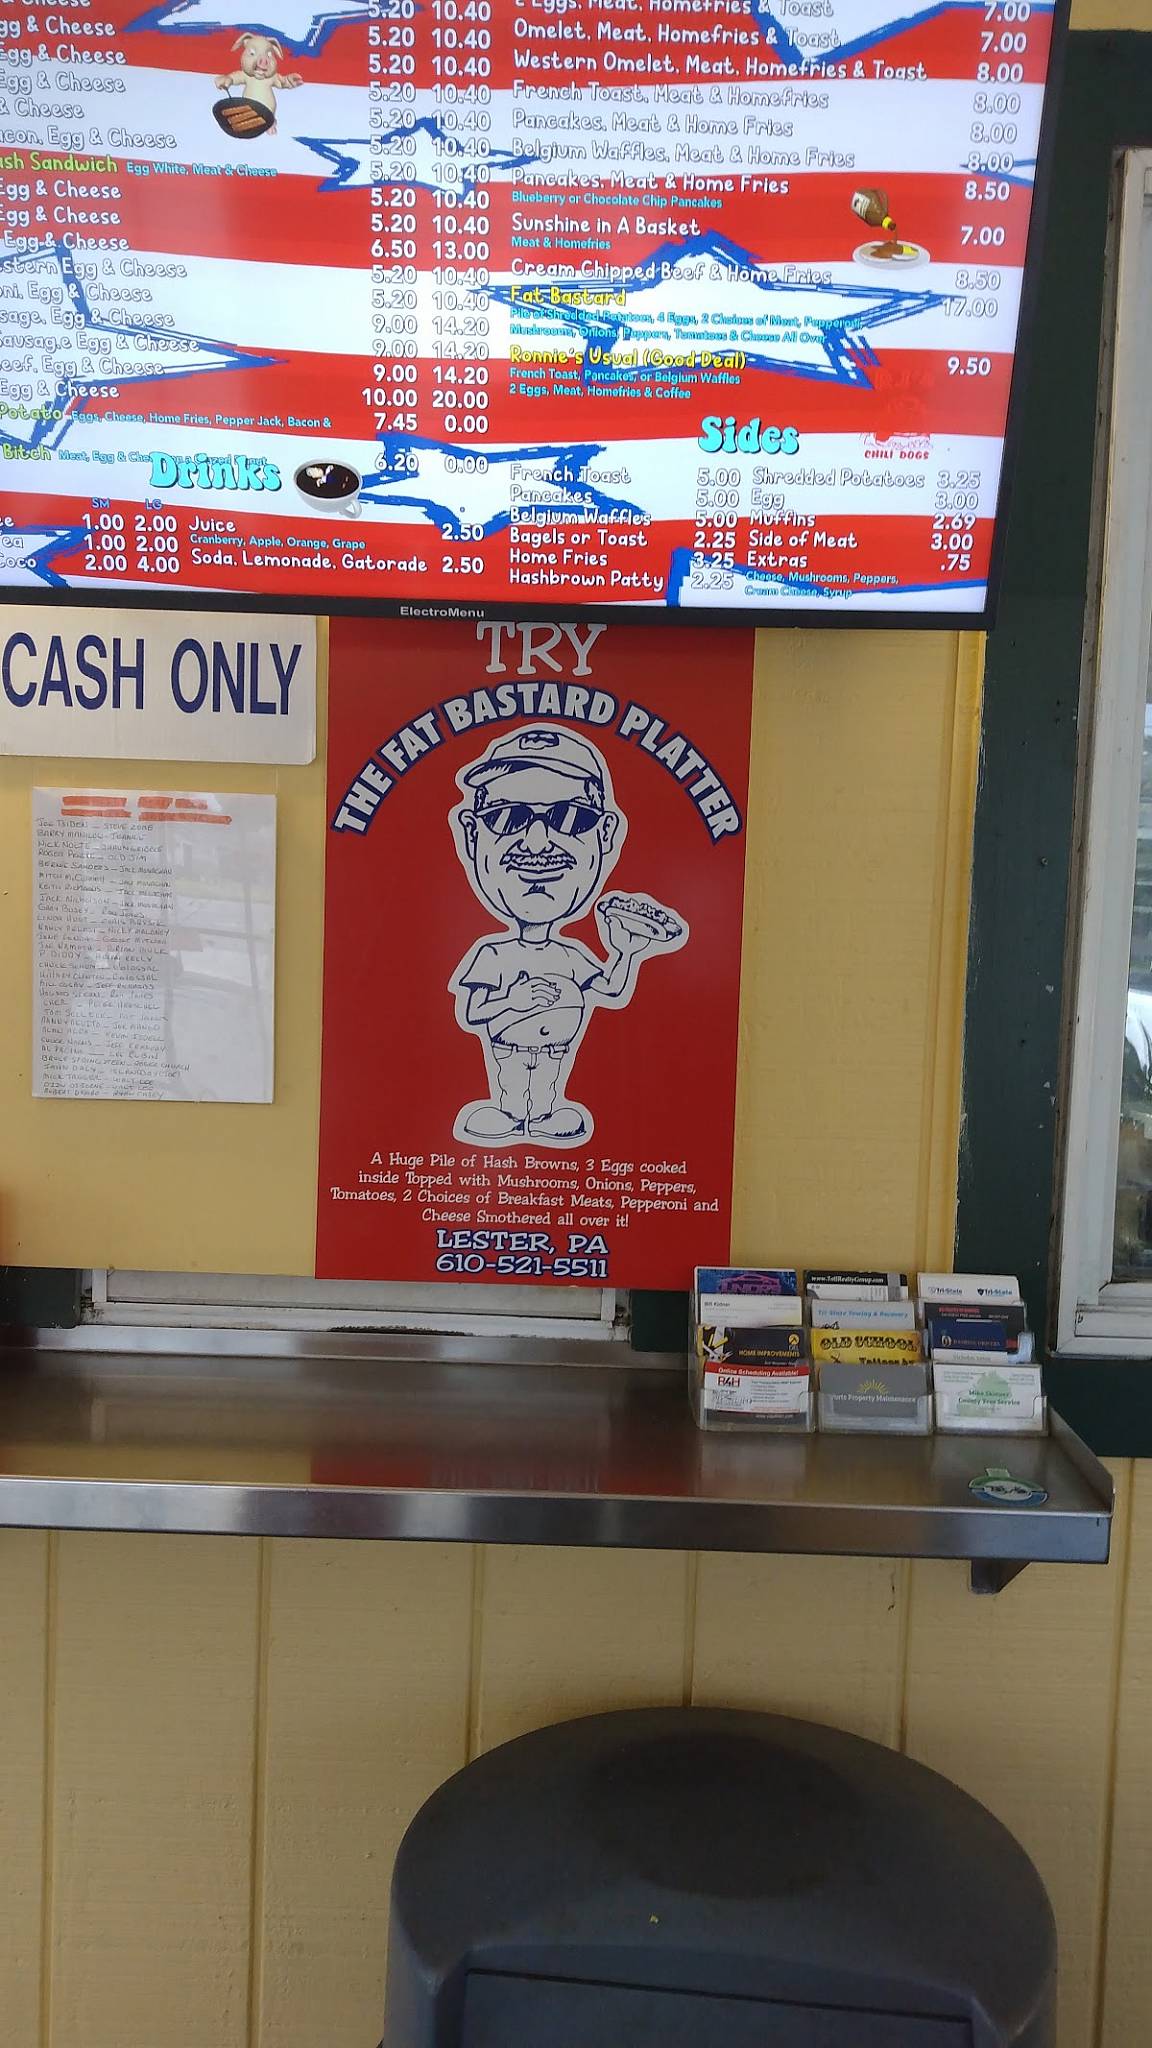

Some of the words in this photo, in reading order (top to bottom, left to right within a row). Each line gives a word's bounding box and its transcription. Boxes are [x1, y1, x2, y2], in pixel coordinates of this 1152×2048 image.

[658, 24, 760, 45] Homefries
[766, 27, 778, 44] &
[785, 27, 842, 48] Toast
[980, 32, 1027, 53] 7.00
[513, 49, 597, 70] Western
[746, 56, 847, 78] Homefries
[853, 59, 865, 78] &
[873, 59, 928, 80] Toast
[977, 62, 1024, 83] 8.00
[30, 152, 118, 173] Sandwich
[126, 162, 150, 176] Egg
[192, 163, 221, 176] Meat
[224, 164, 233, 176] &
[237, 165, 278, 177] Cheese
[511, 191, 566, 206] Blueberry
[569, 194, 581, 204] or
[584, 193, 639, 205] Chocolate
[642, 194, 667, 208] Chip
[671, 195, 723, 208] Pancakes
[511, 212, 591, 233] Sunshine
[597, 216, 612, 234] in
[617, 217, 630, 234] A
[635, 216, 701, 237] Basket
[511, 236, 541, 249] Meat
[543, 237, 552, 249] &
[555, 237, 611, 250] Homefries
[960, 226, 1006, 246] 7.00
[510, 285, 545, 304] Fat
[550, 286, 627, 306] Bastard
[510, 345, 584, 364] Ronnie's
[589, 346, 638, 366] Usual
[643, 349, 696, 368] (Good
[701, 350, 747, 369] Deal)
[948, 357, 991, 376] 9.50
[509, 368, 546, 380] French
[549, 369, 581, 382] Toast,
[584, 369, 636, 382] Pancakes,
[640, 373, 653, 382] or
[655, 371, 698, 385] Belgium
[701, 372, 740, 384] Waffles
[509, 384, 516, 394] 2
[519, 384, 550, 397] Eggs,
[553, 385, 584, 397] Meat,
[587, 385, 641, 398] Homefries
[644, 387, 652, 398] &
[656, 387, 691, 399] Coffee
[374, 412, 418, 431] 7.45
[444, 414, 489, 433] 0.00
[698, 416, 800, 454] Sides
[864, 450, 894, 460] CHILI
[899, 451, 929, 460] DOGS
[150, 451, 283, 490] Drinks
[92, 497, 111, 509] SM
[145, 499, 163, 510] LG
[189, 515, 236, 533] Juice
[750, 510, 816, 528] Muffins
[932, 513, 976, 531] 2.69
[441, 523, 484, 541] 2.50
[510, 527, 567, 547] Bagels
[571, 531, 591, 547] or
[598, 528, 648, 547] Toast
[693, 530, 737, 549] 2.25
[748, 531, 784, 548] Side
[789, 531, 809, 548] of
[813, 532, 858, 550] Meat
[332, 538, 366, 551] Grape
[931, 533, 973, 551] 3.00
[342, 553, 428, 572] Gatorade
[441, 556, 484, 574] 2.50
[510, 548, 559, 566] Home
[563, 550, 608, 567] Fries
[747, 551, 808, 569] Extras
[940, 553, 971, 571] .75
[509, 568, 605, 587] Hashbrown
[610, 570, 664, 593] Patty
[746, 571, 786, 585] Cheese,
[788, 572, 850, 585] Mushrooms,
[853, 573, 899, 586] Peppers,
[400, 607, 485, 618] ElectroMenu
[476, 621, 608, 676] TRY
[2, 632, 145, 710] CASH
[171, 638, 302, 716] ONLY
[333, 761, 395, 833] THE
[380, 710, 446, 773] FAT
[442, 681, 616, 733] BASTARD
[618, 703, 742, 840] PLATTER
[371, 1152, 383, 1165] A
[389, 1153, 424, 1169] Huge
[430, 1153, 456, 1167] Pile
[461, 1154, 477, 1167] of
[483, 1155, 518, 1168] Hash
[525, 1156, 579, 1172] Browns,
[585, 1158, 595, 1171] 3
[600, 1159, 634, 1174] Eggs
[639, 1160, 687, 1175] cooked
[358, 1170, 400, 1184] inside
[405, 1172, 453, 1188] Topped
[458, 1173, 491, 1187] with
[497, 1175, 580, 1191] Mushrooms,
[585, 1177, 634, 1193] Onions,
[640, 1179, 697, 1195] Peppers,
[330, 1187, 397, 1203] Tomatoes,
[402, 1189, 412, 1202] 2
[417, 1189, 470, 1205] Choices
[476, 1191, 493, 1205] of
[498, 1192, 564, 1207] Breakfast
[570, 1194, 615, 1209] Meats,
[620, 1196, 688, 1212] Pepperoni
[693, 1198, 720, 1213] and
[421, 1208, 472, 1223] Cheese
[476, 1210, 551, 1226] Smothered
[557, 1213, 574, 1226] all
[579, 1214, 609, 1228] over
[615, 1214, 629, 1228] it!
[436, 1229, 555, 1255] LESTER,
[568, 1232, 609, 1255] PA
[435, 1253, 609, 1279] 610-521-5511
[718, 1367, 737, 1375] Online
[738, 1368, 771, 1376] Scheduling
